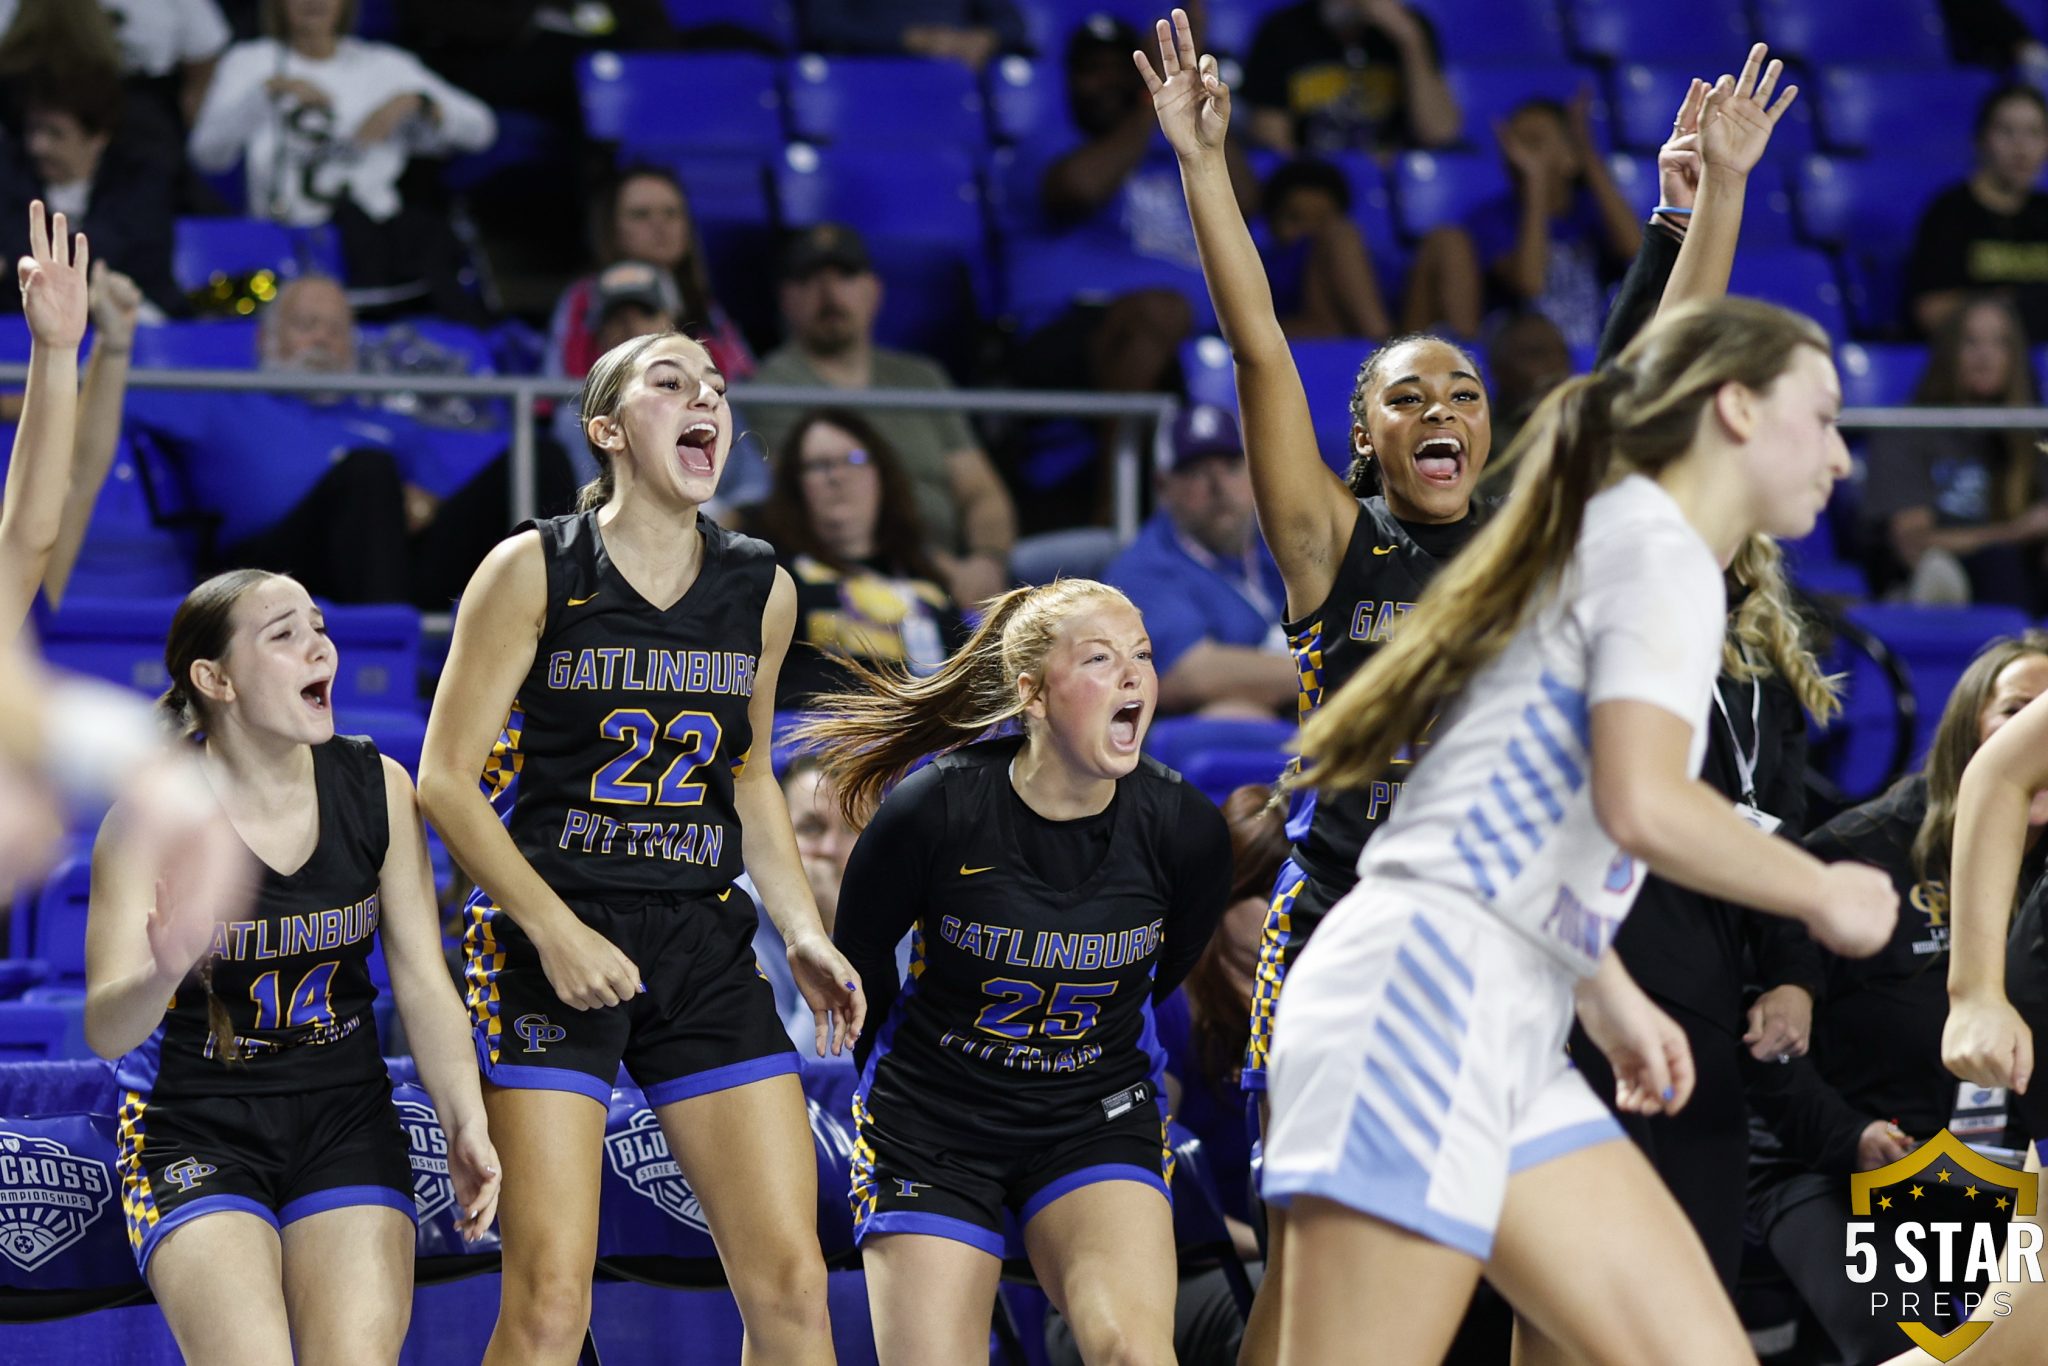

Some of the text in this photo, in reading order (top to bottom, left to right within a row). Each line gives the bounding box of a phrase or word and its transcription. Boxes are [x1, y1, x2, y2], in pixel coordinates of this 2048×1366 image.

[590, 708, 722, 806] 22
[558, 808, 724, 868] PITTMAN
[207, 887, 380, 962] ATLINBUR
[940, 915, 1164, 971] GATLINBURG
[249, 960, 341, 1030] 14
[973, 976, 1119, 1040] 25
[1134, 1089, 1146, 1102] M
[615, 1130, 670, 1169] BLU
[640, 1163, 671, 1180] STATE
